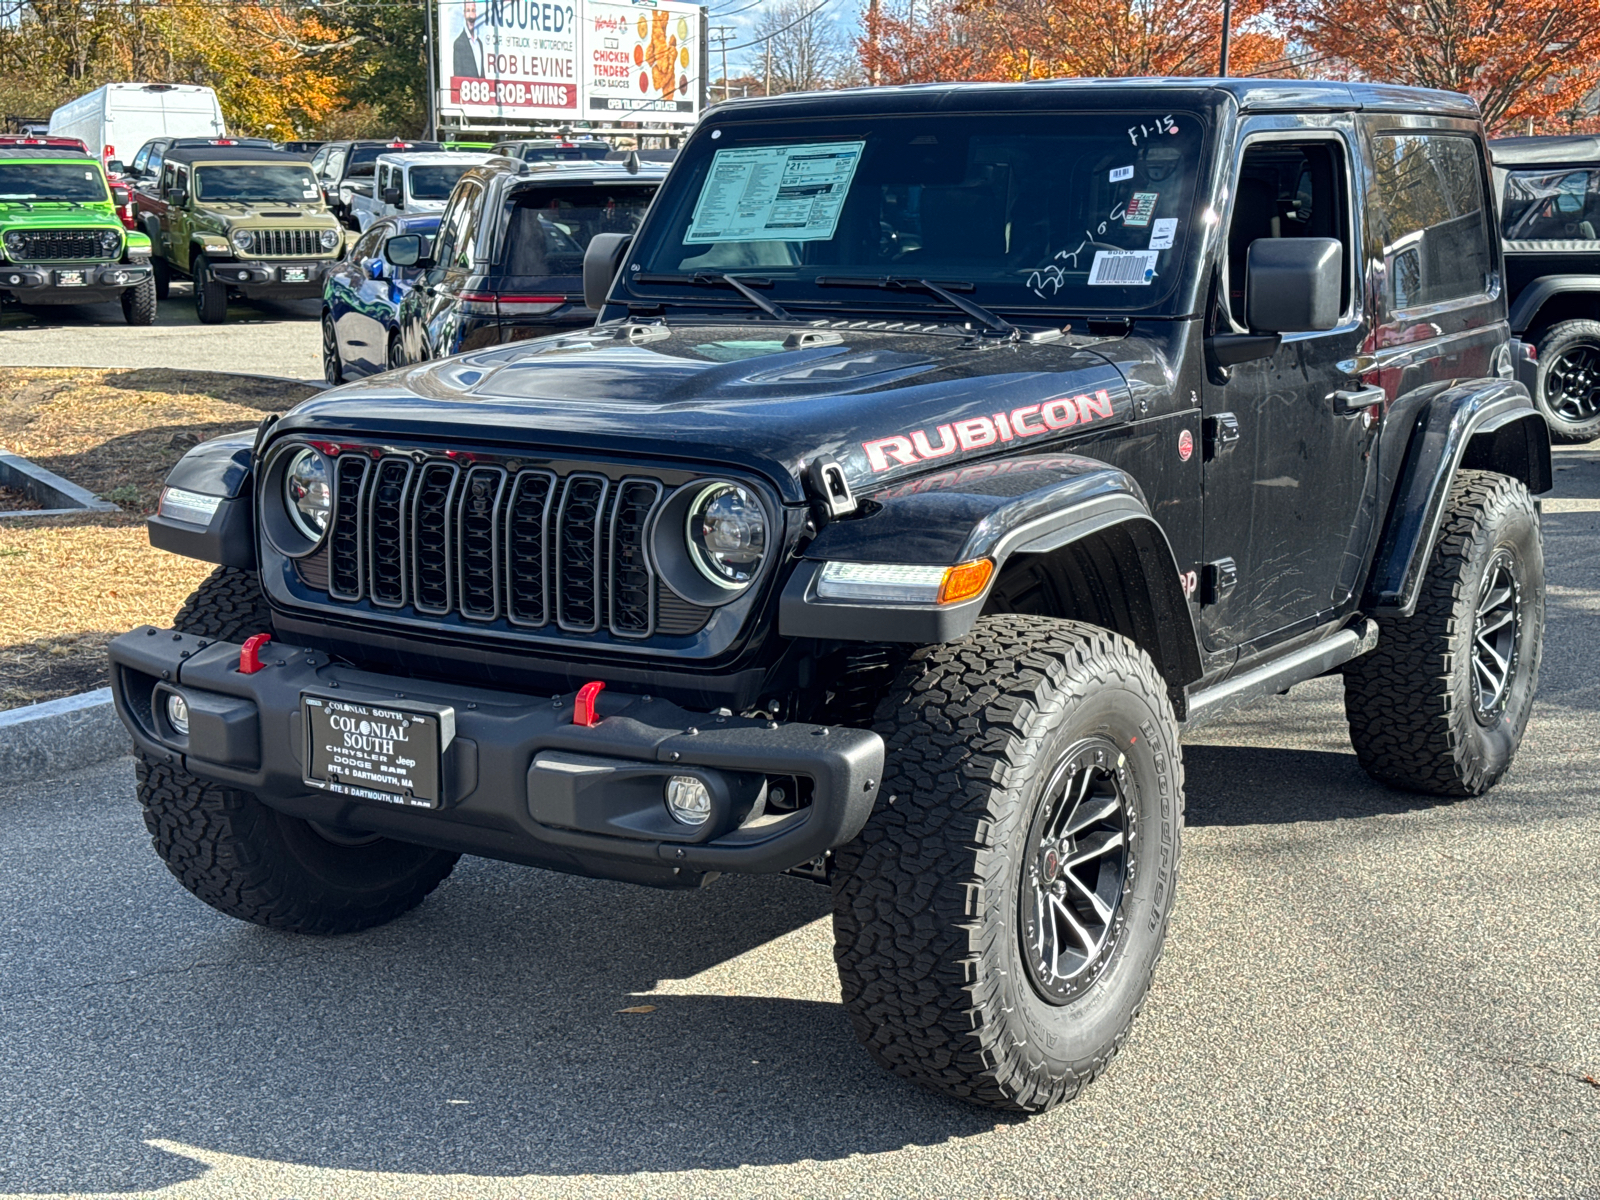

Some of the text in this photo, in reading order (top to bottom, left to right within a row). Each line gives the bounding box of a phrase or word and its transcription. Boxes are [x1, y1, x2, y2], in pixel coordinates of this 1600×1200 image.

[485, 0, 573, 34] INJURED?
[487, 53, 573, 78] ROB LEVINE
[593, 50, 630, 63] CHICKEN
[593, 64, 630, 78] TENDERS
[460, 81, 568, 106] 888-ROB-WINS
[1127, 114, 1174, 146] F1-15
[789, 162, 801, 170] 21
[862, 389, 1114, 473] RUBICON
[1179, 570, 1198, 600] ep
[328, 701, 369, 716] COLONIAL
[372, 709, 403, 720] SOUTH
[411, 715, 425, 724] Jeep
[329, 715, 409, 742] COLONIAL
[343, 732, 395, 755] SOUTH
[325, 745, 416, 768] CHRYSLER Jeep
[333, 755, 407, 775] DODGE RAM
[328, 764, 343, 774] RTE.
[352, 769, 400, 786] DARTMOUTH,
[401, 779, 413, 788] MA
[329, 784, 345, 793] RTE.
[351, 788, 393, 803] DARTMOUTH,
[393, 796, 404, 804] MA
